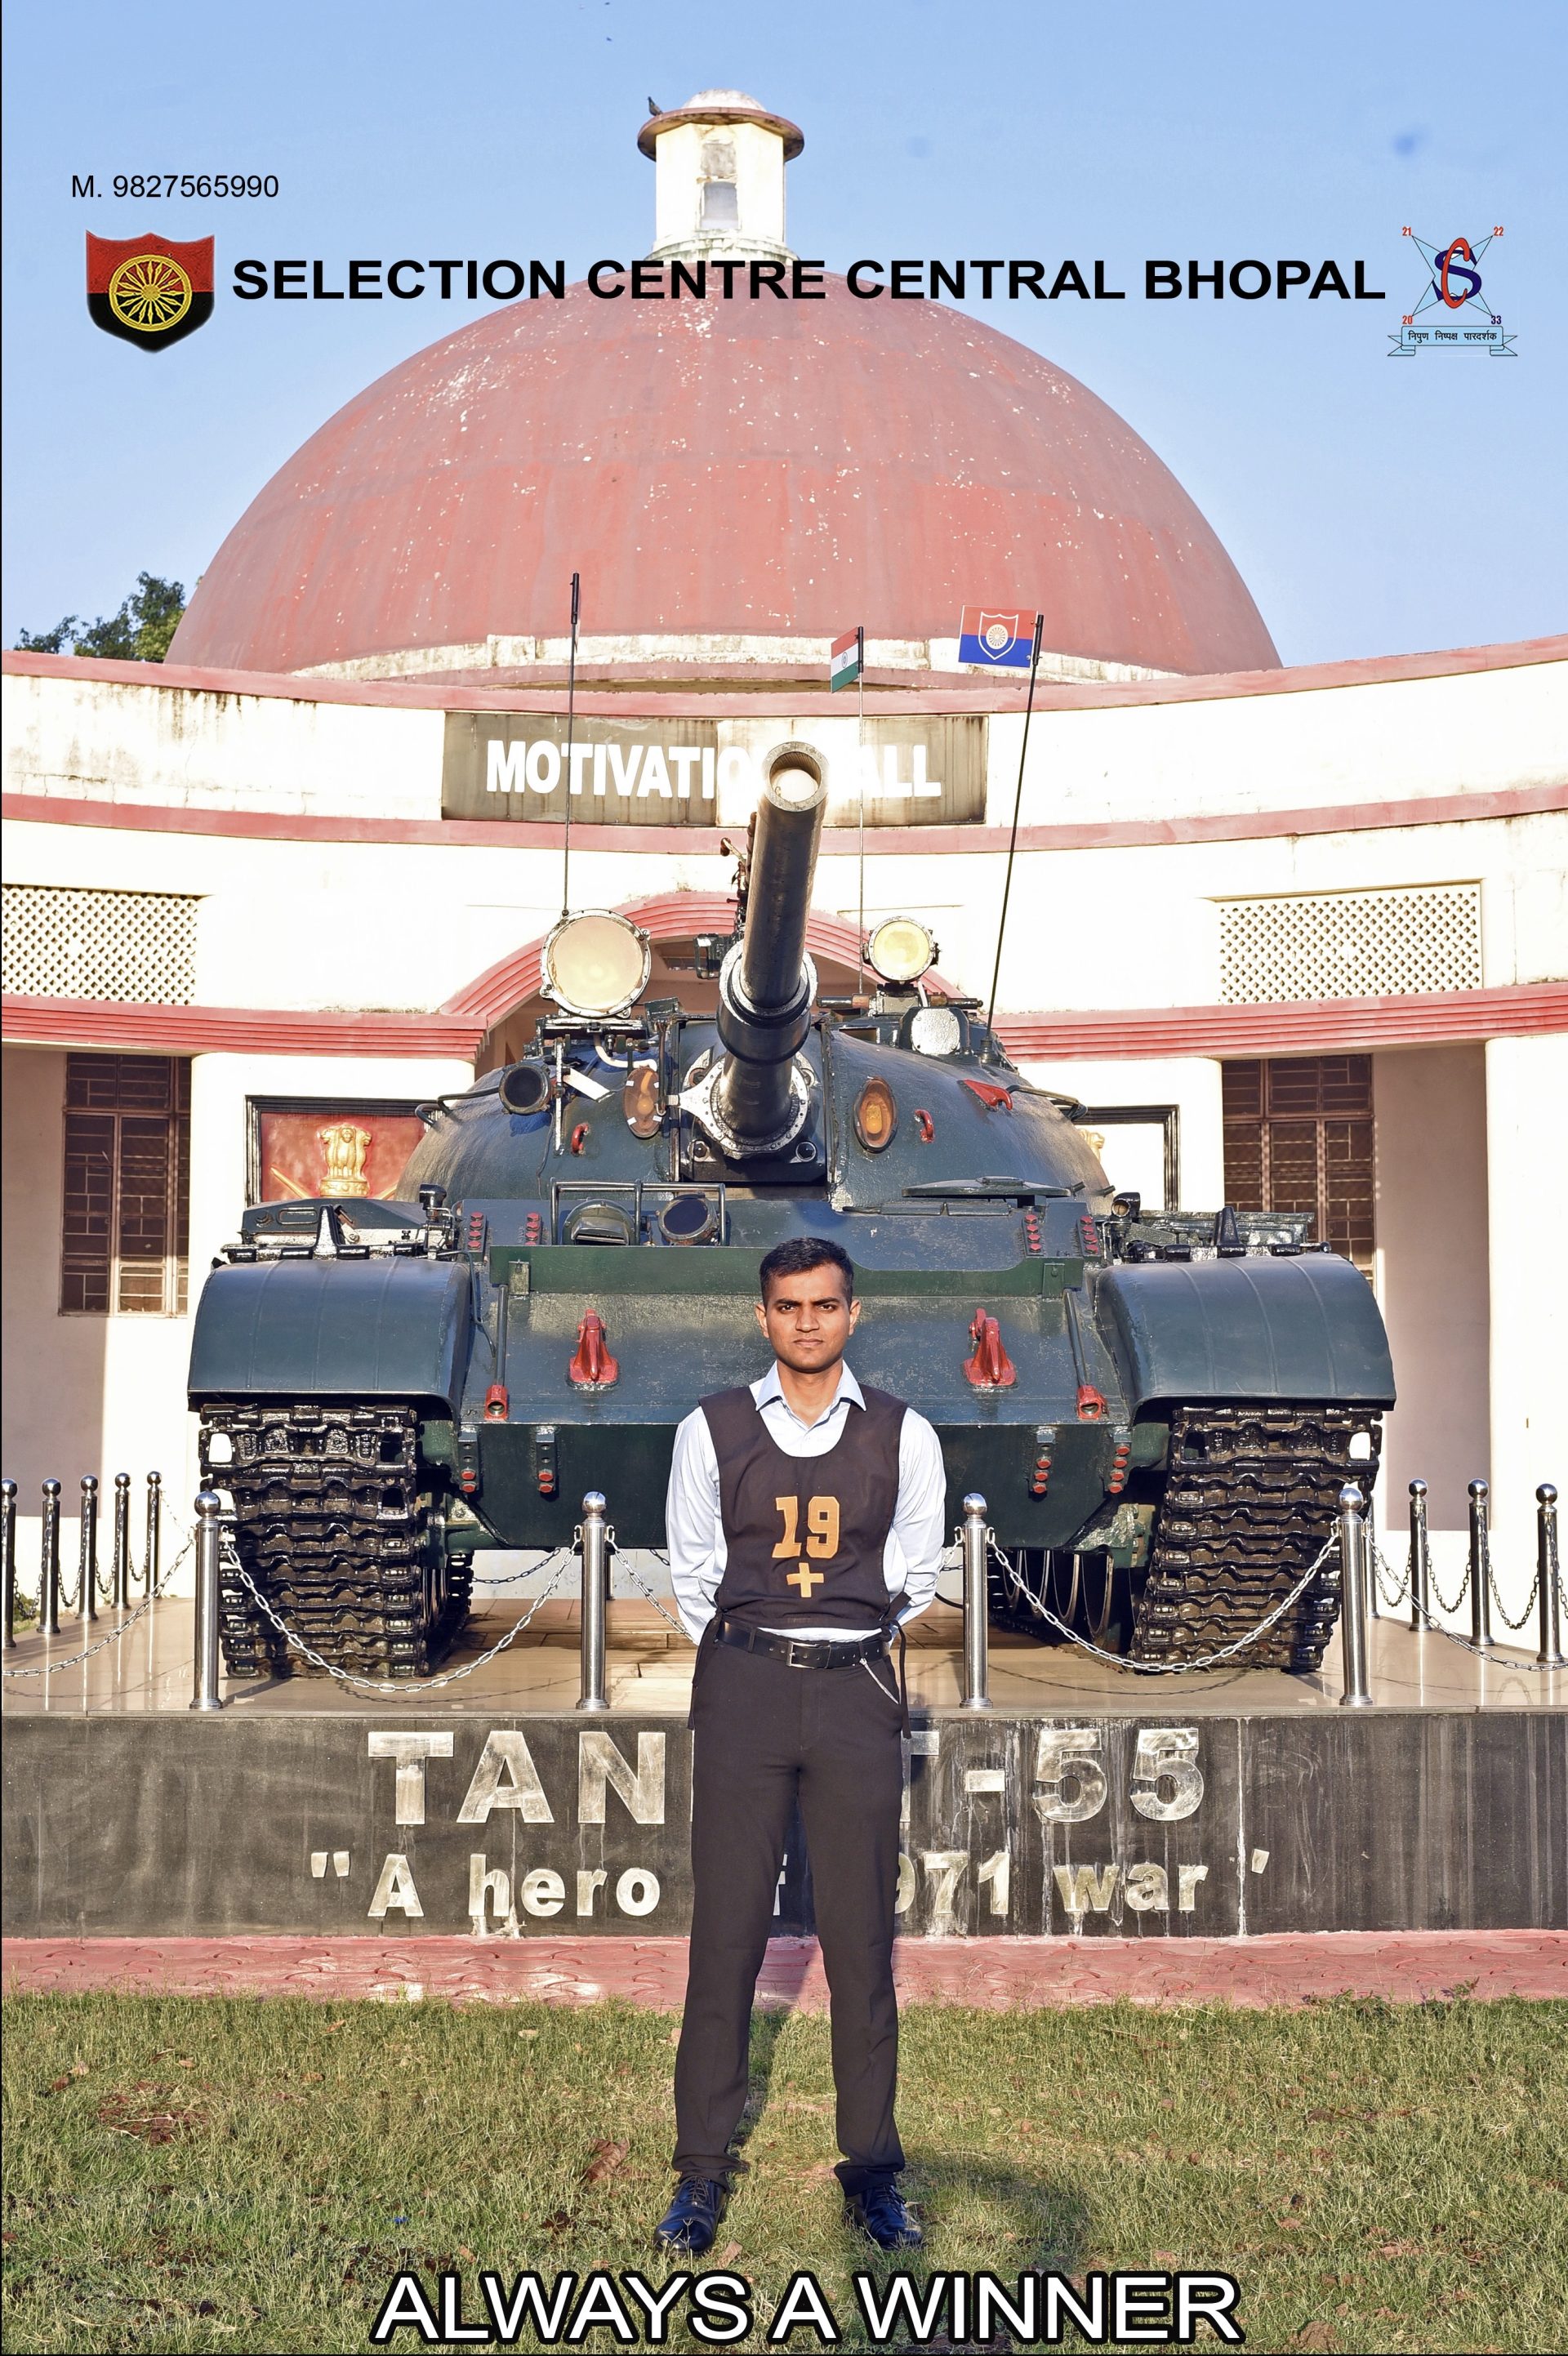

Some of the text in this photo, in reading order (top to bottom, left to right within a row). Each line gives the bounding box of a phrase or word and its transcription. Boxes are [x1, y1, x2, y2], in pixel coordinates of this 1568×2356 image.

[487, 740, 942, 800] MOTIVATIO ALL
[771, 1495, 840, 1559] 19
[368, 1730, 694, 1824] TAN
[468, 1853, 661, 1917] hero
